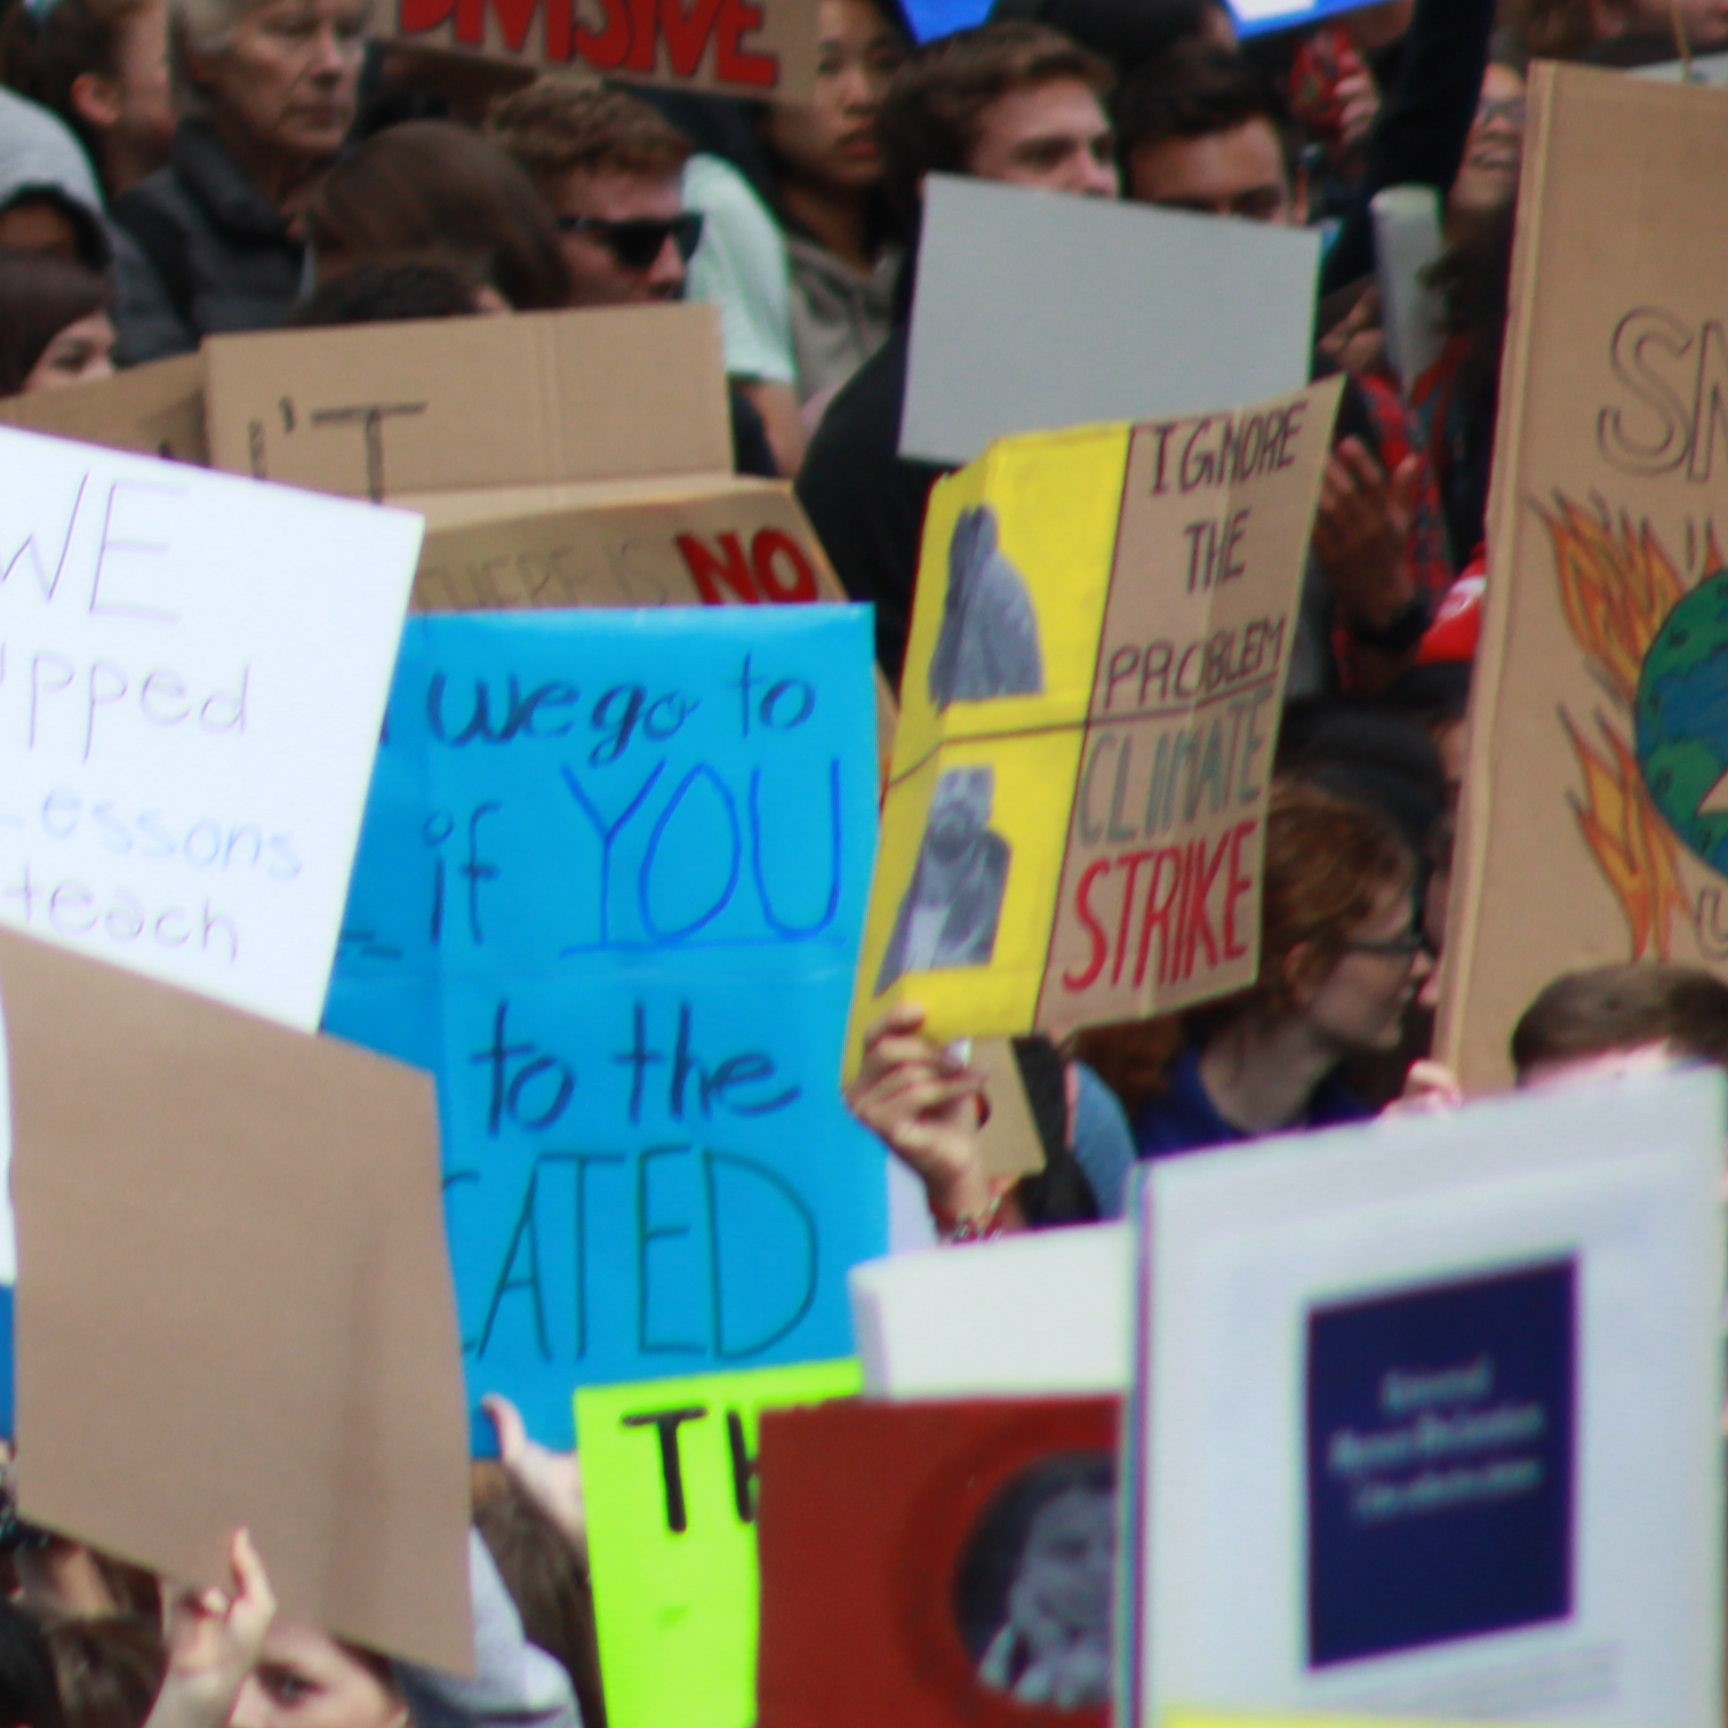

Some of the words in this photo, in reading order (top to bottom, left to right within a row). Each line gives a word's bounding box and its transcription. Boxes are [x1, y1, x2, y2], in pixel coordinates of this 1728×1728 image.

[675, 525, 820, 607] NO
[1185, 508, 1249, 593] THE
[587, 676, 700, 768] go
[734, 652, 816, 739] to
[1103, 615, 1285, 709] PROBLEM
[1078, 685, 1275, 847] CLIMATE
[13, 857, 239, 961] teach
[420, 801, 504, 947] if
[560, 755, 844, 944] YOU
[1062, 818, 1257, 993] STRIKE
[471, 997, 574, 1137] to
[612, 997, 804, 1128] the
